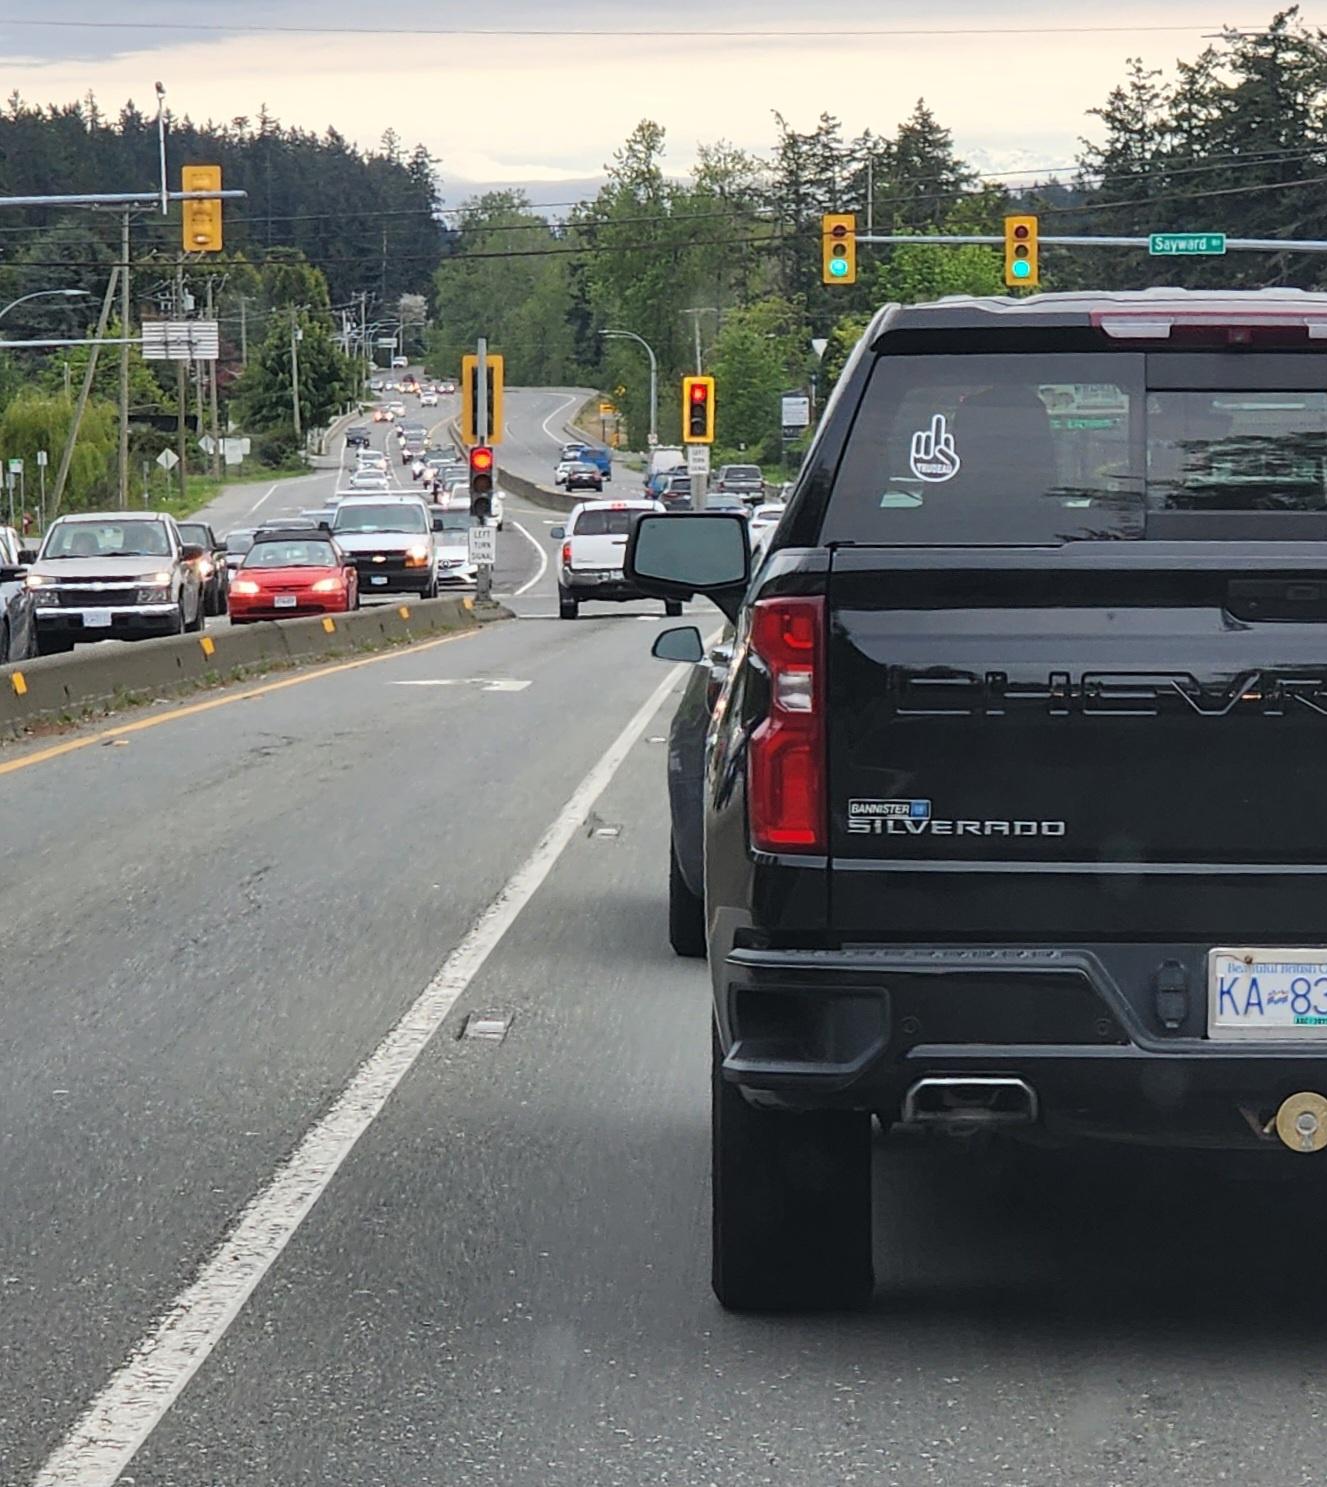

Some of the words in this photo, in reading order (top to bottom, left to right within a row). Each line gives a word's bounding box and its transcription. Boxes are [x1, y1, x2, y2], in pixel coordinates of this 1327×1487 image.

[1154, 237, 1207, 253] Sayward
[474, 530, 490, 539] LEFT
[473, 541, 491, 549] TURN
[471, 552, 493, 561] SIGNAL
[851, 803, 910, 815] BANNISTER
[848, 819, 1065, 835] SILVERADO
[1219, 976, 1265, 1016] KA
